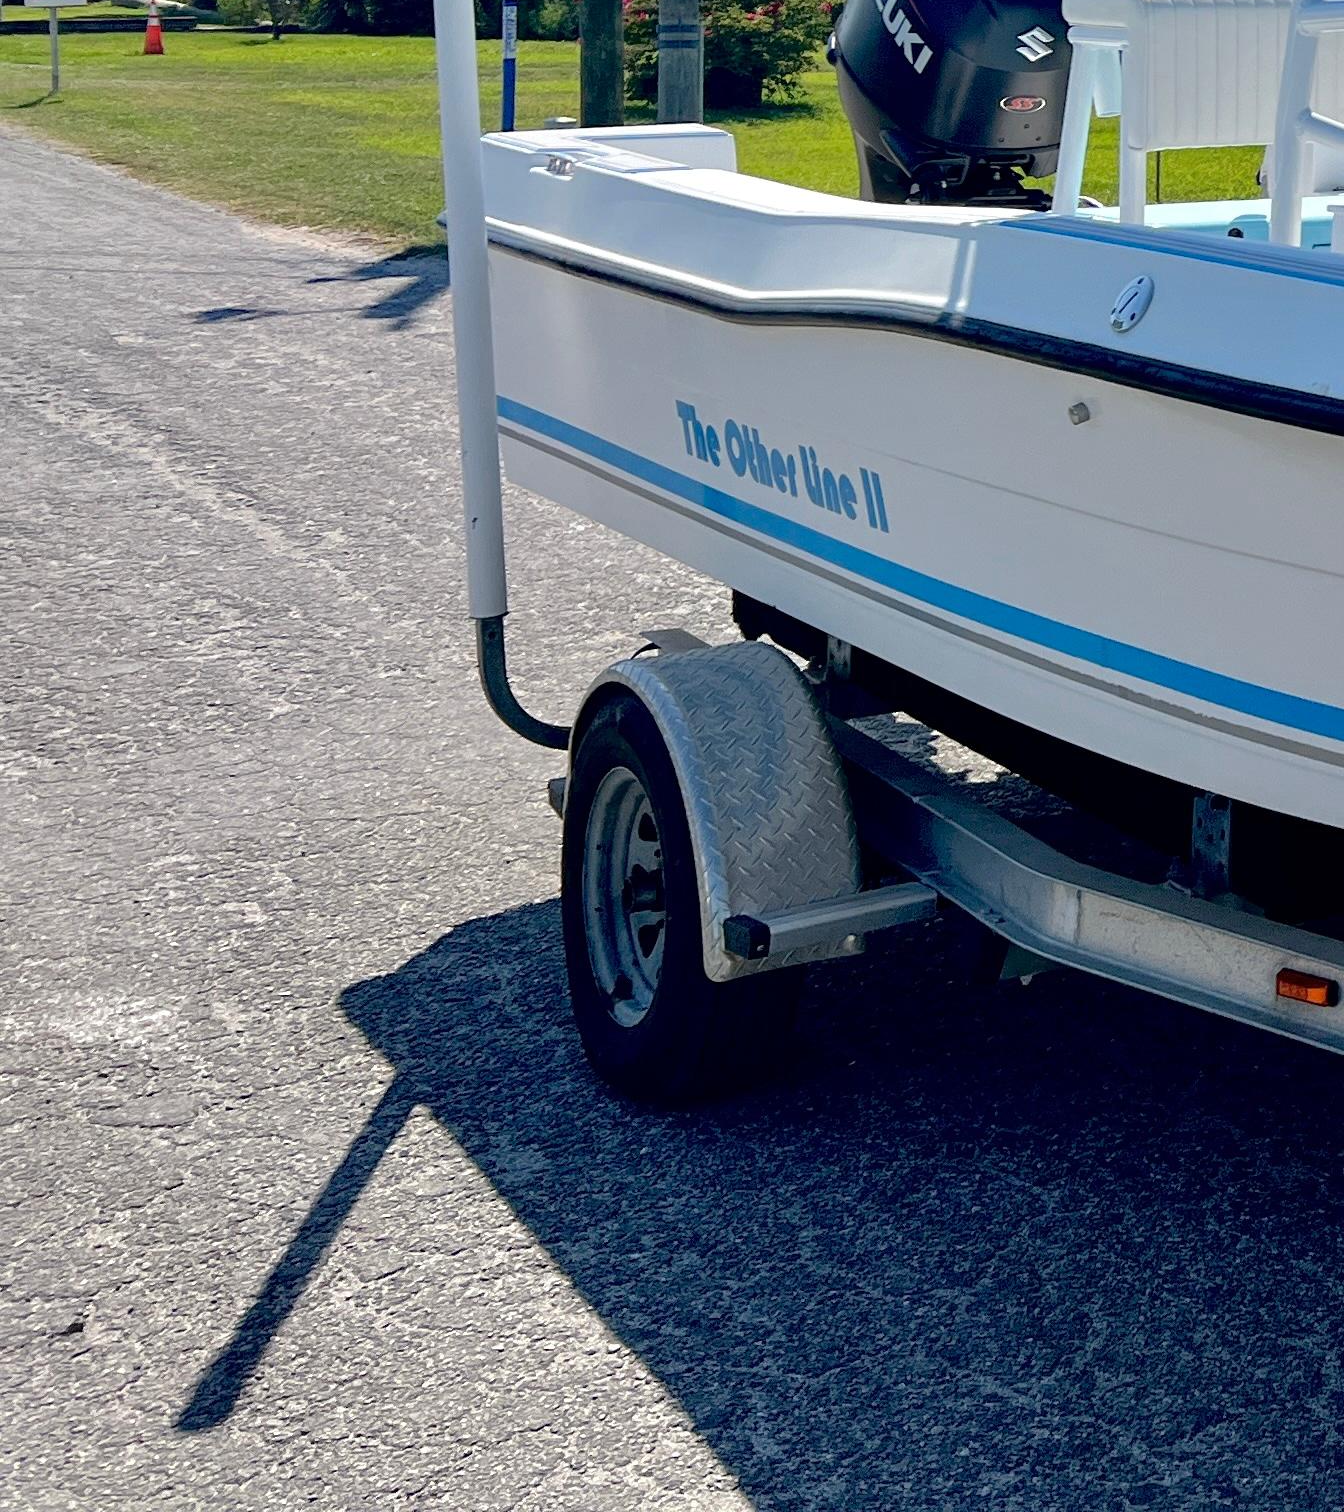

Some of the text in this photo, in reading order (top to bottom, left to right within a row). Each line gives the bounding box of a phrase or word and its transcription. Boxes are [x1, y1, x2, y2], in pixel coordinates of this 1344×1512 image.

[675, 399, 890, 534] The Other Line II
